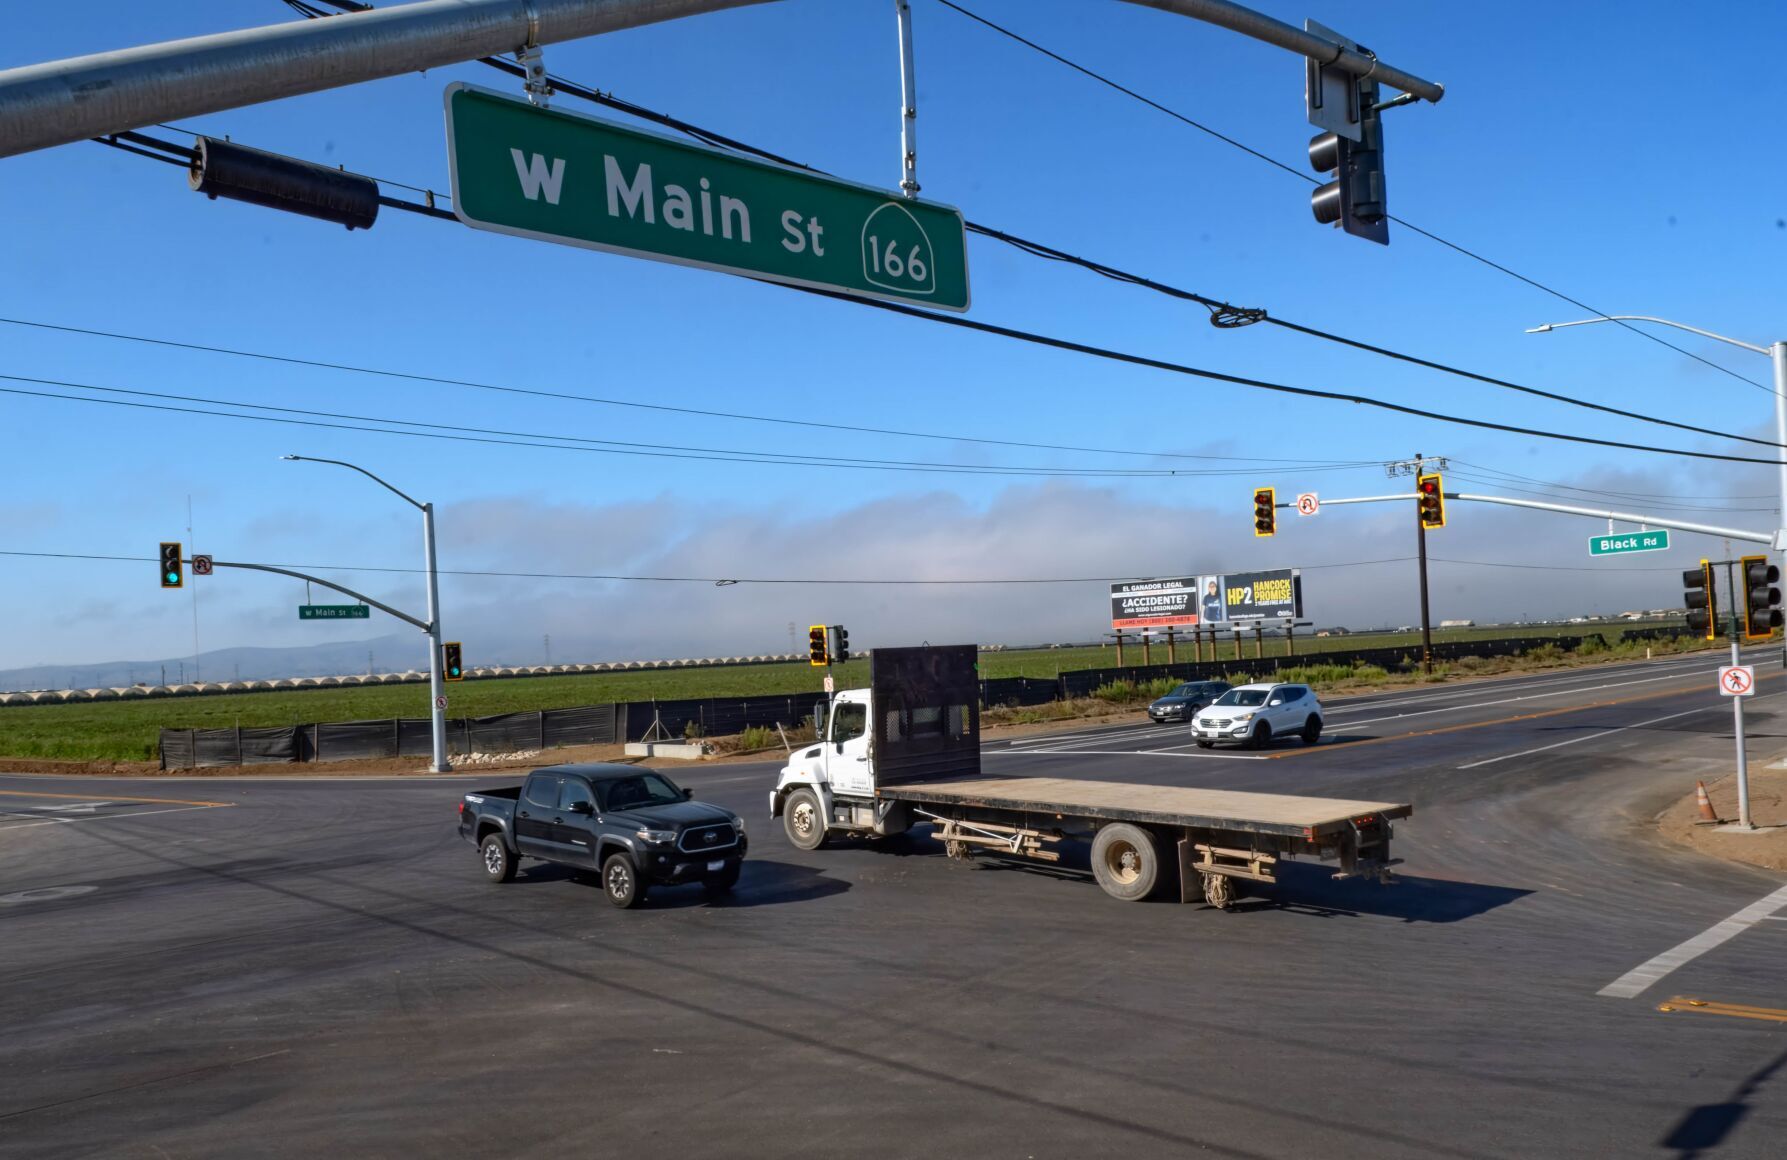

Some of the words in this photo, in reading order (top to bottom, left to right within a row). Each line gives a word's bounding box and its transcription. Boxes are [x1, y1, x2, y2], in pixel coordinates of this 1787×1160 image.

[510, 147, 566, 205] W
[604, 155, 751, 243] Main
[781, 210, 825, 257] St
[869, 235, 927, 281] 166
[1600, 538, 1638, 550] Black
[1643, 538, 1657, 547] Rd
[1131, 583, 1162, 591] GANADOR
[1253, 579, 1291, 591] HANCOCK
[1122, 594, 1188, 608] ¿ACCIDENTE?
[1227, 587, 1252, 605] HP2
[1254, 589, 1292, 602] PROMISE
[315, 608, 336, 616] Main
[1150, 604, 1186, 612] LESIONADO?
